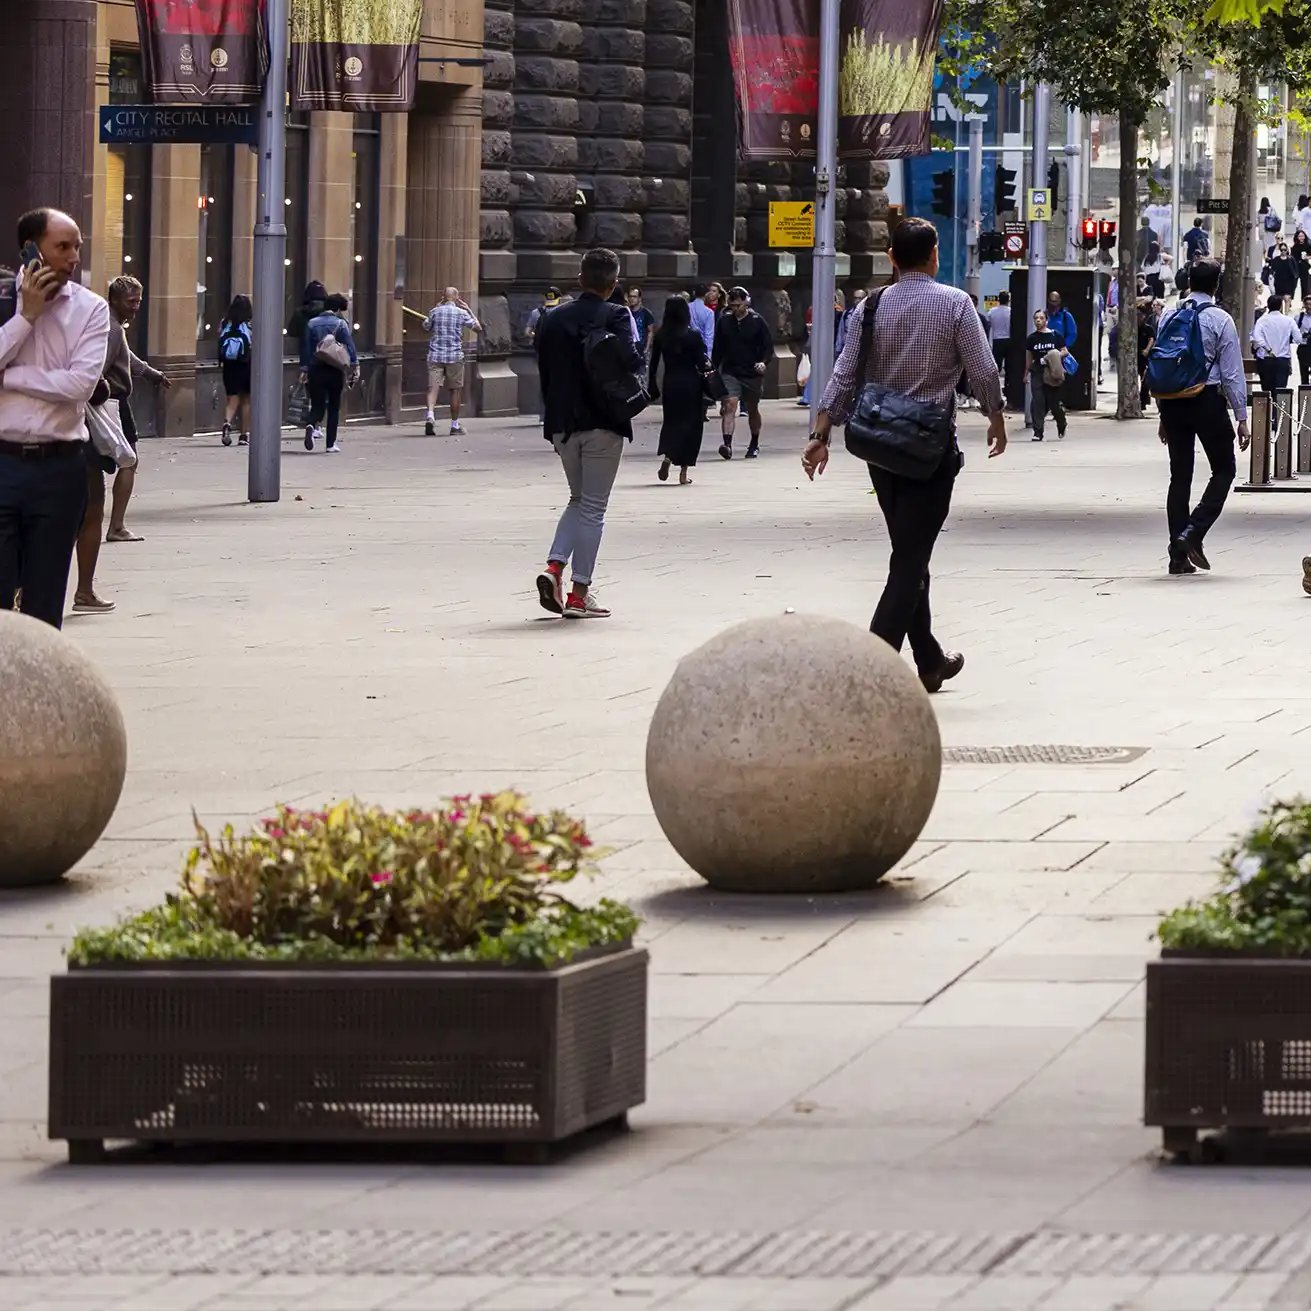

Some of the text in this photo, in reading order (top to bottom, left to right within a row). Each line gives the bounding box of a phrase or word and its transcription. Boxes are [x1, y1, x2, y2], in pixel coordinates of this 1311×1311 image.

[116, 111, 254, 125] CITY RECITAL HALL
[931, 93, 988, 122] NZ
